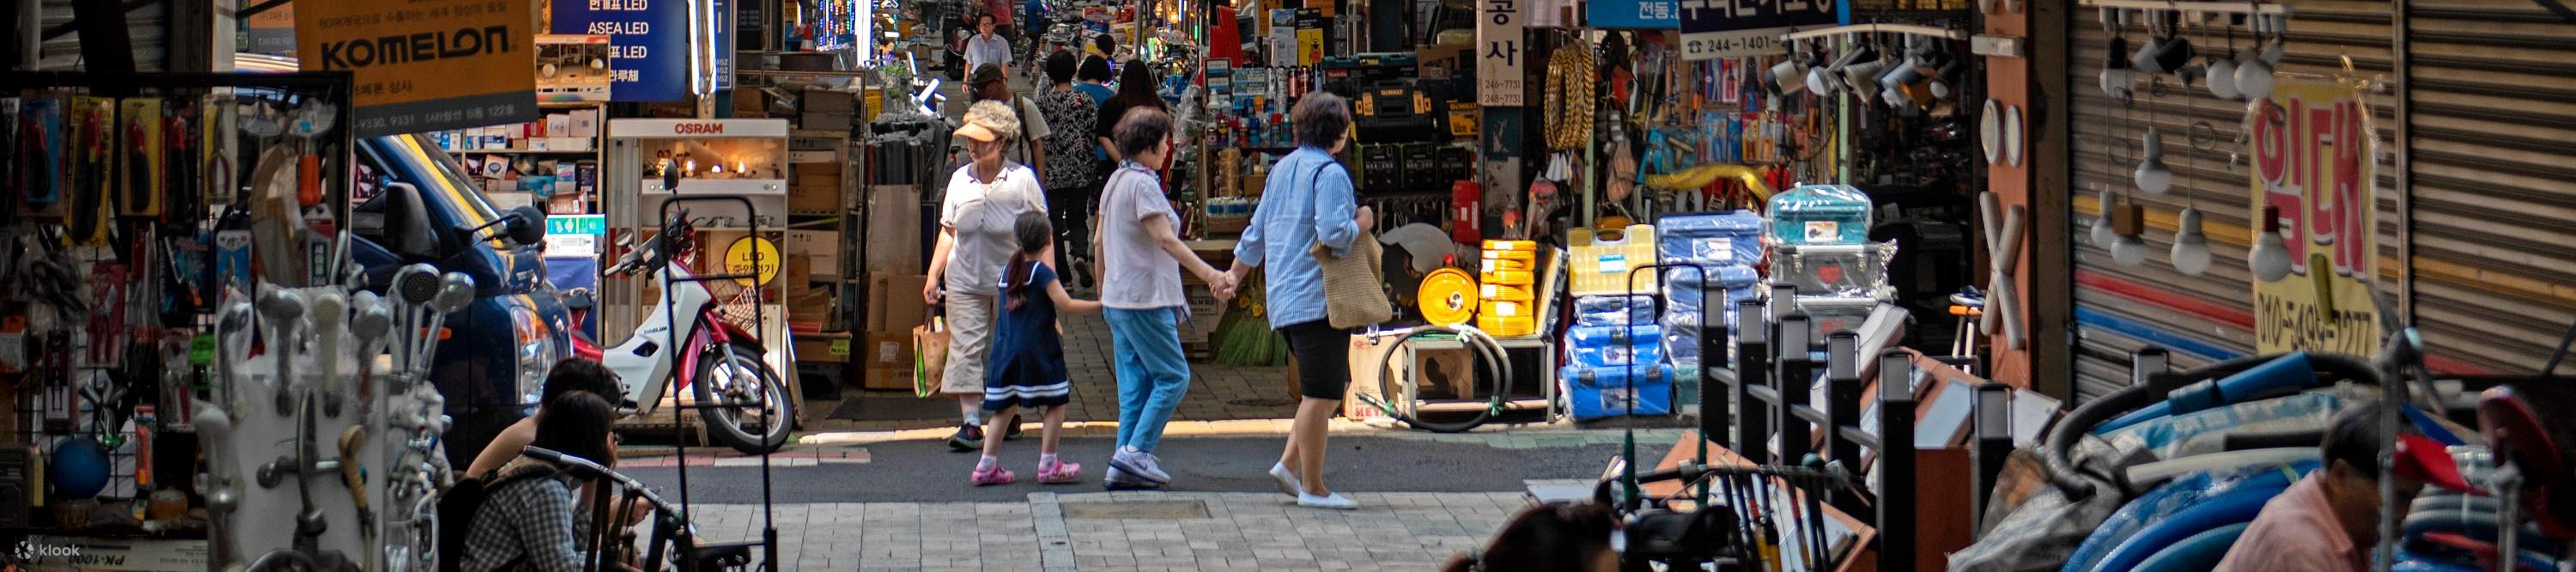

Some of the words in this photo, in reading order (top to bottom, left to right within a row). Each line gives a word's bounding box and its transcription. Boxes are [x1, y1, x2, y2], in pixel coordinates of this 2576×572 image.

[624, 0, 647, 10] LED
[588, 22, 623, 34] ASEA
[625, 22, 649, 34] LED
[623, 46, 647, 58] LED
[674, 123, 724, 134] OSRAM
